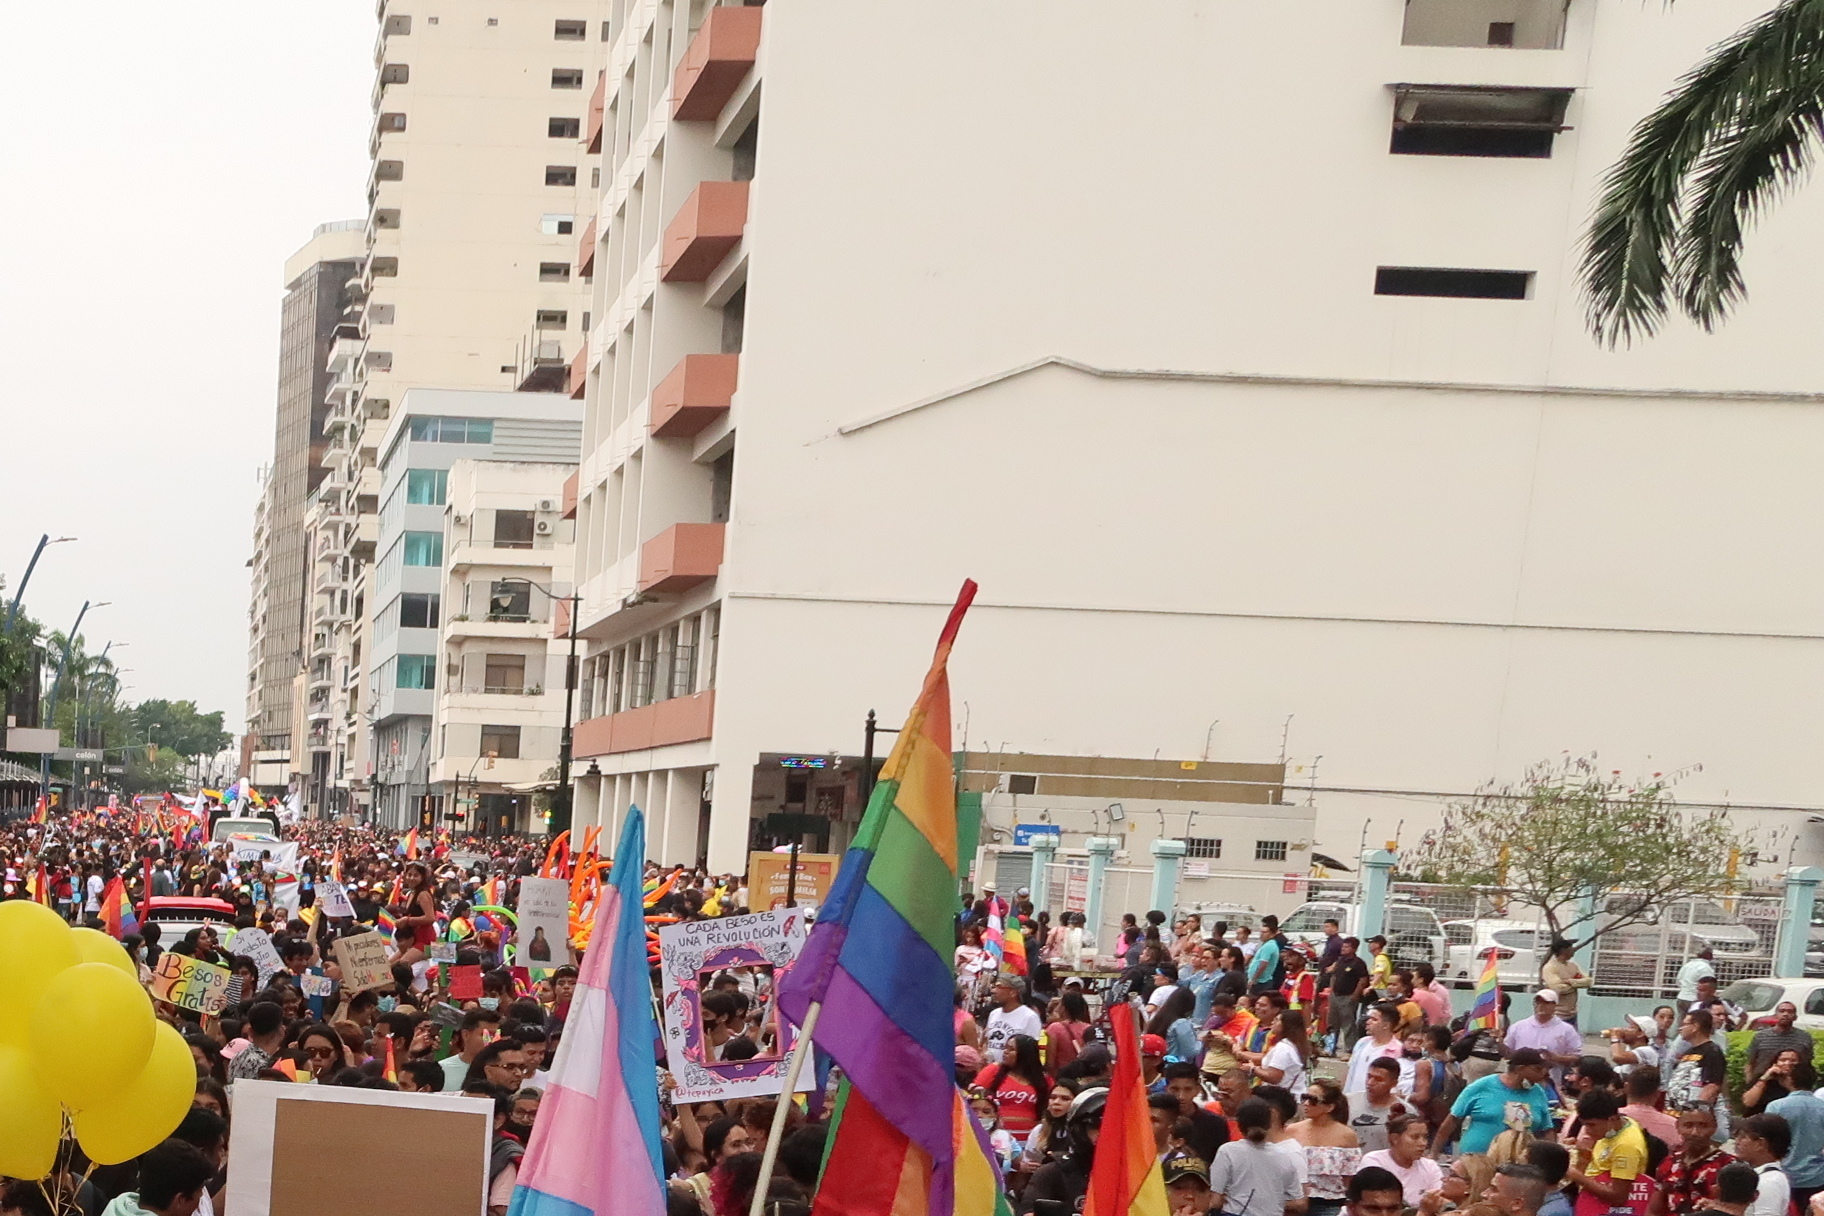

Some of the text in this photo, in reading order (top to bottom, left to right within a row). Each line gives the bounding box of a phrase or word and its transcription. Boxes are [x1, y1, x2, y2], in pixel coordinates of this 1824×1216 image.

[685, 912, 775, 934] CADA BESO ES
[678, 935, 702, 947] UNA
[158, 953, 222, 987] Besos
[166, 979, 220, 1012] Gratis
